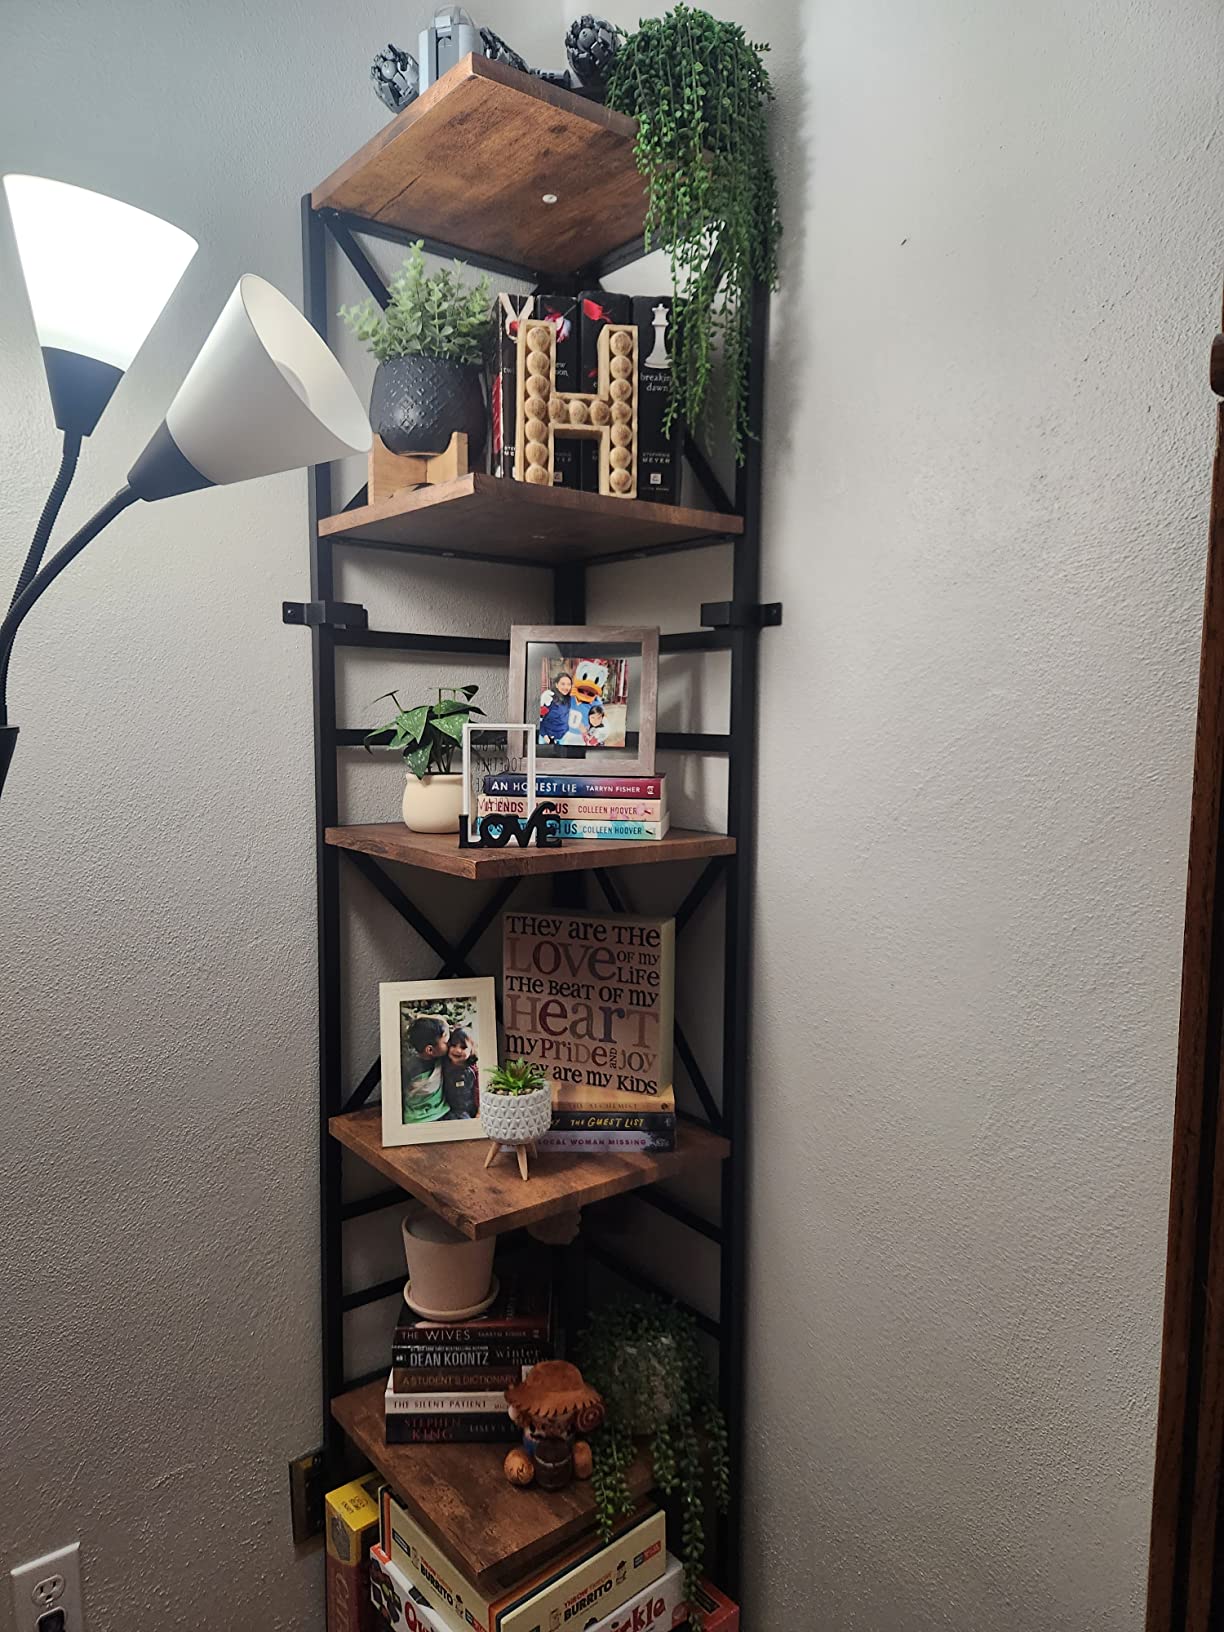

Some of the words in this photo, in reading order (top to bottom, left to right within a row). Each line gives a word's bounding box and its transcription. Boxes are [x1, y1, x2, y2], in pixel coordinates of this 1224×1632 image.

[640, 372, 672, 384] breakin
[646, 382, 670, 393] dawn
[491, 781, 509, 792] AN
[562, 783, 578, 793] LIE
[586, 785, 614, 793] TARRYN
[498, 802, 525, 813] ENDS
[578, 805, 608, 814] COLLEEN
[610, 807, 638, 815] HOOVER
[564, 824, 578, 835] US
[582, 826, 612, 835] COLLEEN
[614, 827, 642, 835] HOOVER
[568, 920, 608, 942] are
[552, 1067, 584, 1083] are
[586, 1070, 614, 1088] my
[587, 1116, 623, 1129] GUEST
[538, 1138, 567, 1146] LOCAL
[570, 1138, 605, 1146] WOMAN
[608, 1138, 648, 1147] MISSING
[402, 1331, 419, 1341] THE
[425, 1329, 472, 1341] WIVES
[409, 1352, 441, 1367] DEAN
[443, 1351, 490, 1367] KOONTZ
[402, 1376, 410, 1385] A
[393, 1400, 409, 1410] THE
[415, 1400, 445, 1410] SILENT
[449, 1400, 487, 1410] PATIENT
[563, 1579, 613, 1622] BURRITO
